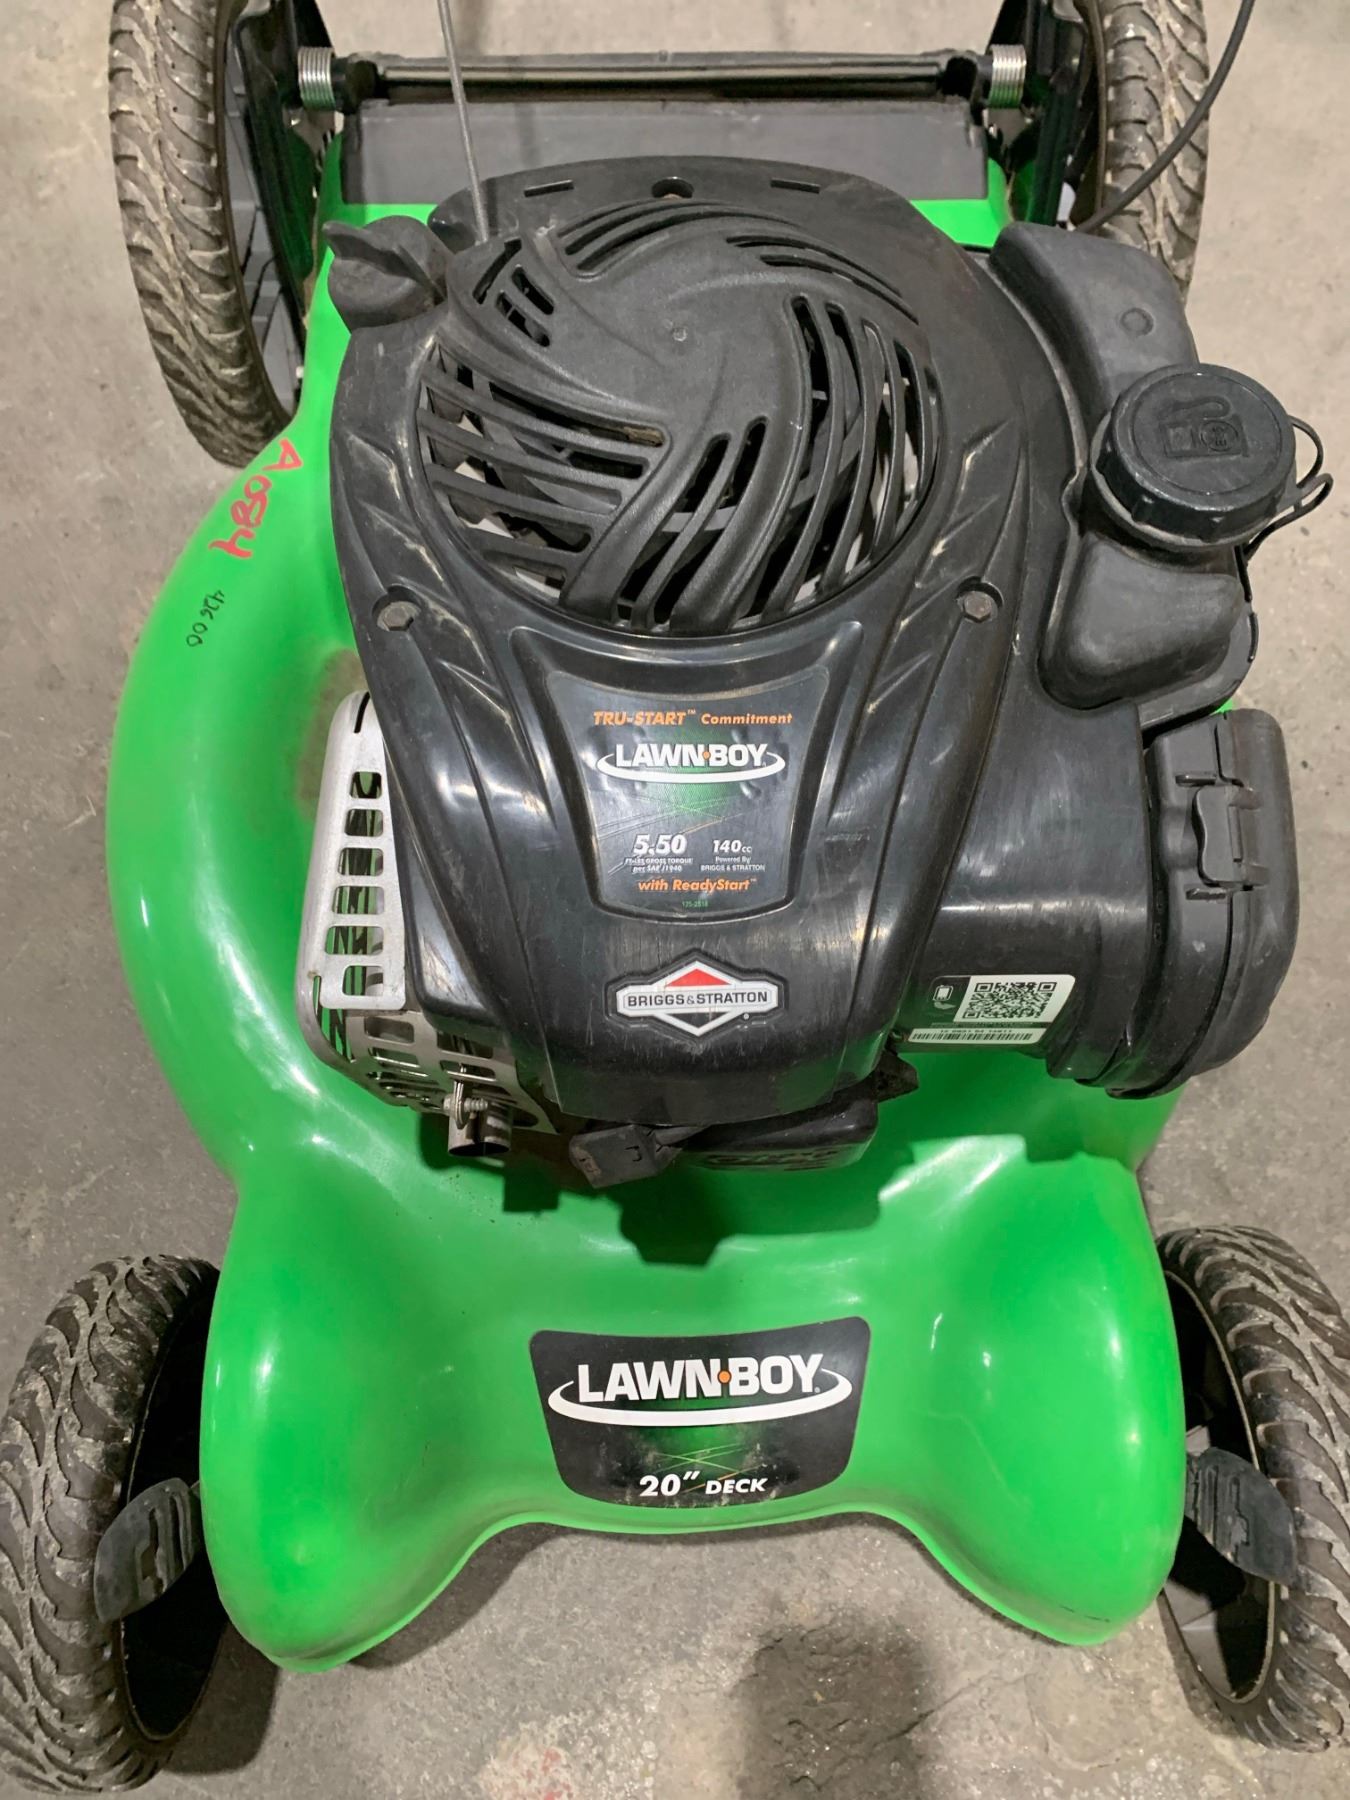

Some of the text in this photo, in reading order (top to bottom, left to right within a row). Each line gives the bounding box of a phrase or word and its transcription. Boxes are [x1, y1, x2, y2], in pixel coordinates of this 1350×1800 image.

[701, 713, 793, 725] Commitment
[633, 834, 688, 856] 5.50
[638, 878, 669, 891] with
[705, 1478, 768, 1495] DECK
